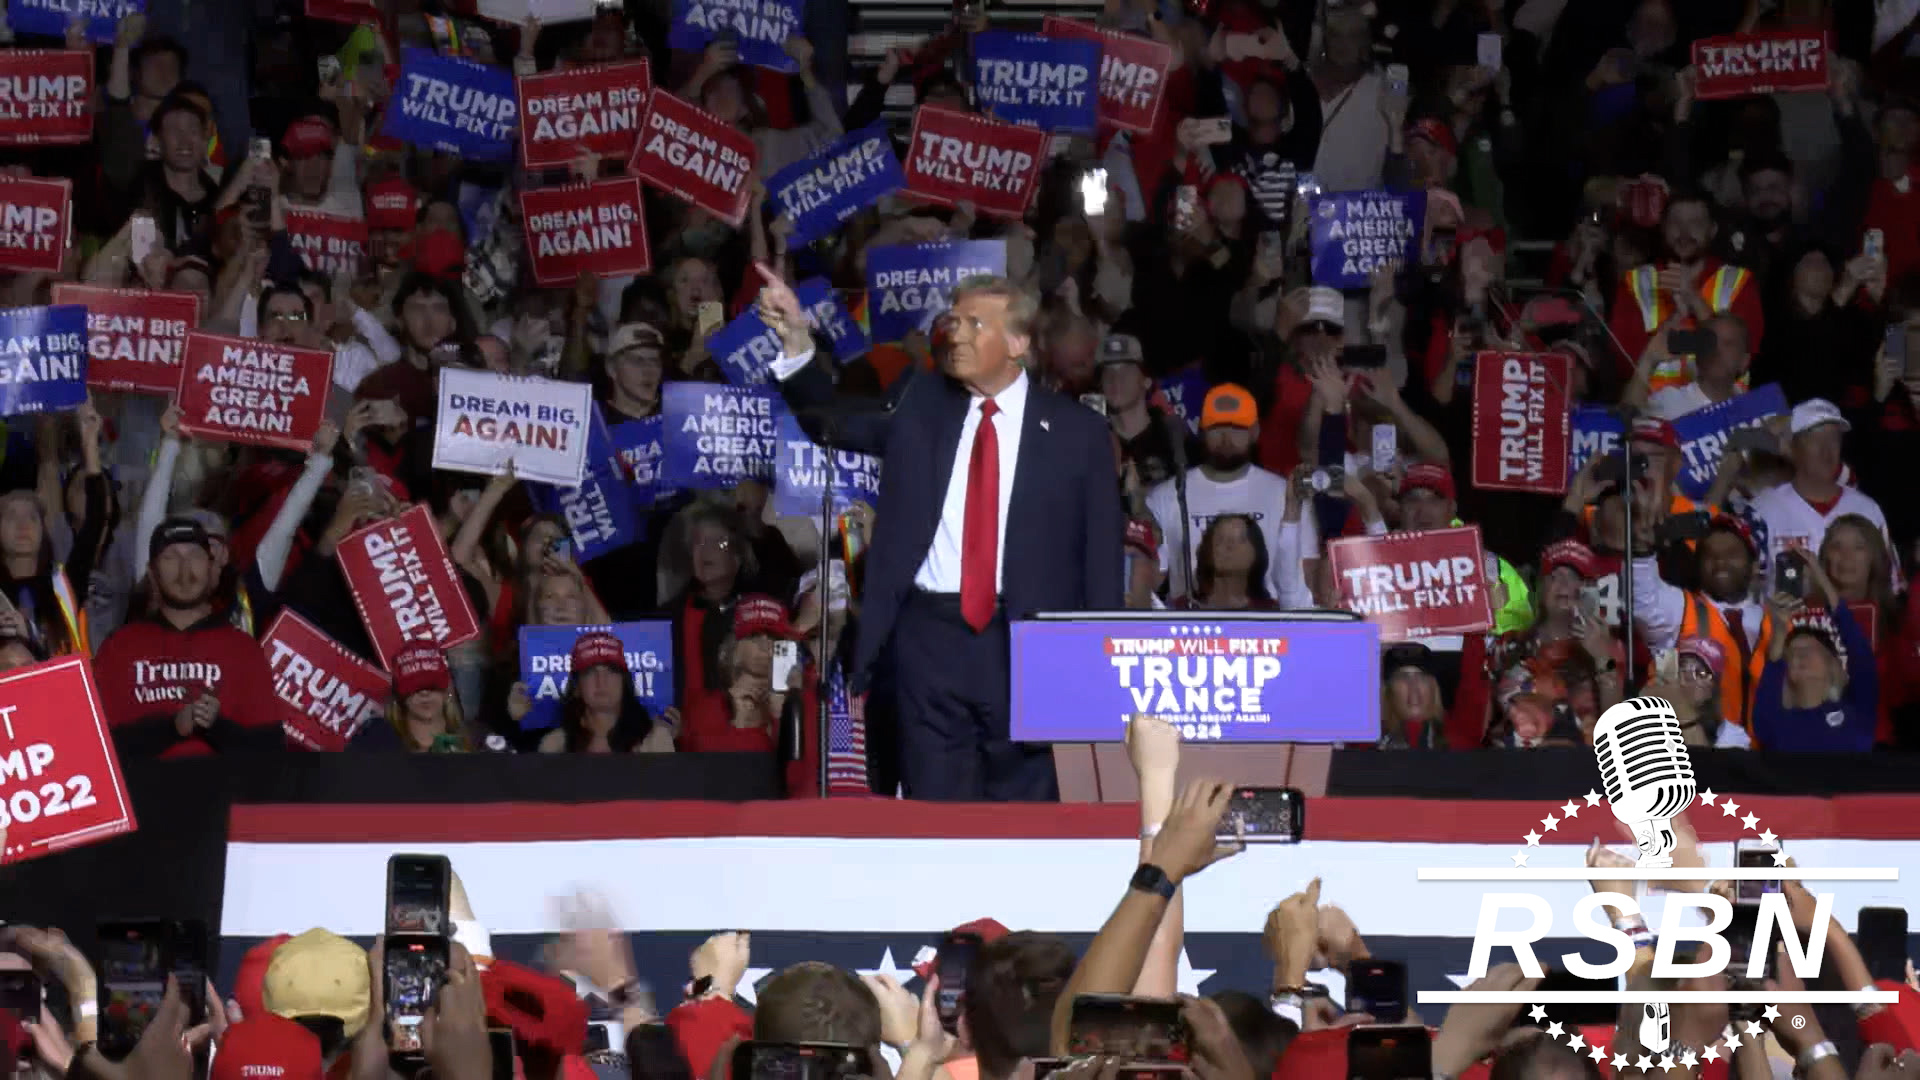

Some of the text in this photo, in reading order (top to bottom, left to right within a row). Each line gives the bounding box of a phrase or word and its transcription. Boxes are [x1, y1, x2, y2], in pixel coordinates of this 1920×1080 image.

[685, 4, 790, 45] AGAIN!
[1703, 39, 1820, 64] TRUMP
[1703, 54, 1820, 78] WILL FIX IT
[977, 58, 1088, 89] TRUMP
[28, 102, 61, 120] FIX
[66, 102, 84, 118] IT
[407, 72, 516, 122] TRUMP
[527, 90, 603, 117] DREAM
[976, 84, 1086, 108] WILL FIX IT
[1130, 90, 1153, 110] IT
[402, 98, 512, 142] WILL FIX IT
[533, 108, 638, 142] AGAIN!
[650, 111, 718, 156] DREAM
[644, 133, 744, 196] AGAIN!
[920, 131, 1032, 176] TRUMP
[777, 138, 881, 209] TRUMP
[833, 169, 866, 195] FIX
[867, 154, 885, 176] IT
[915, 155, 1025, 195] WILL FIX IT
[529, 205, 593, 234] DREAM
[1346, 199, 1404, 219] MAKE
[34, 232, 55, 251] IT
[538, 223, 633, 258] AGAIN!
[1329, 218, 1415, 241] AMERICA
[1343, 239, 1407, 257] GREAT
[876, 266, 951, 288] DREAM
[880, 287, 952, 316] AGA
[223, 345, 296, 375] MAKE
[197, 364, 311, 397] AMERICA
[210, 385, 295, 413] GREAT
[450, 393, 581, 430] DREAM BIG,
[704, 393, 771, 417] MAKE
[205, 406, 294, 433] AGAIN!
[453, 413, 569, 453] AGAIN!
[1500, 358, 1529, 482] TRUMP
[1524, 361, 1546, 483] WILL FIX IT
[696, 435, 775, 457] GREAT
[788, 467, 881, 497] WILL FIX
[390, 526, 415, 547] IT
[400, 546, 429, 585] FIX
[1342, 556, 1476, 599] TRUMP
[364, 532, 428, 641] TRUMP
[1348, 584, 1478, 616] WILL FIX IT
[418, 584, 451, 642] WILL
[1111, 637, 1281, 656] TRUMP WILL FIX IT
[133, 660, 222, 689] Trump
[1111, 655, 1282, 688] TRUMP
[134, 685, 187, 704] Vance
[1130, 687, 1262, 713] VANCE
[240, 1064, 285, 1077] TRUMP
